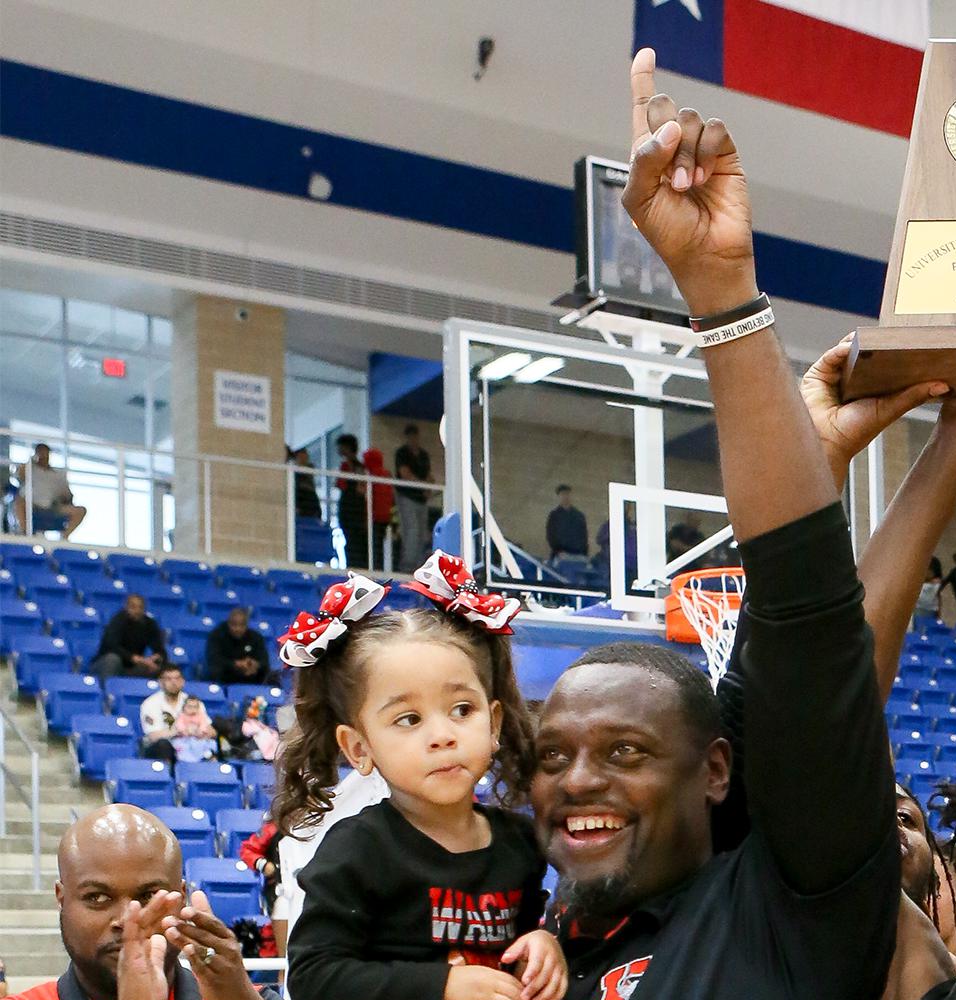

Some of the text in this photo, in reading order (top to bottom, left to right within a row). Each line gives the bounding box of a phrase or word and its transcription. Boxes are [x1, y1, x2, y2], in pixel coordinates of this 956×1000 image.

[736, 317, 765, 334] BEYOND
[720, 328, 737, 338] THE
[702, 334, 721, 345] GAME
